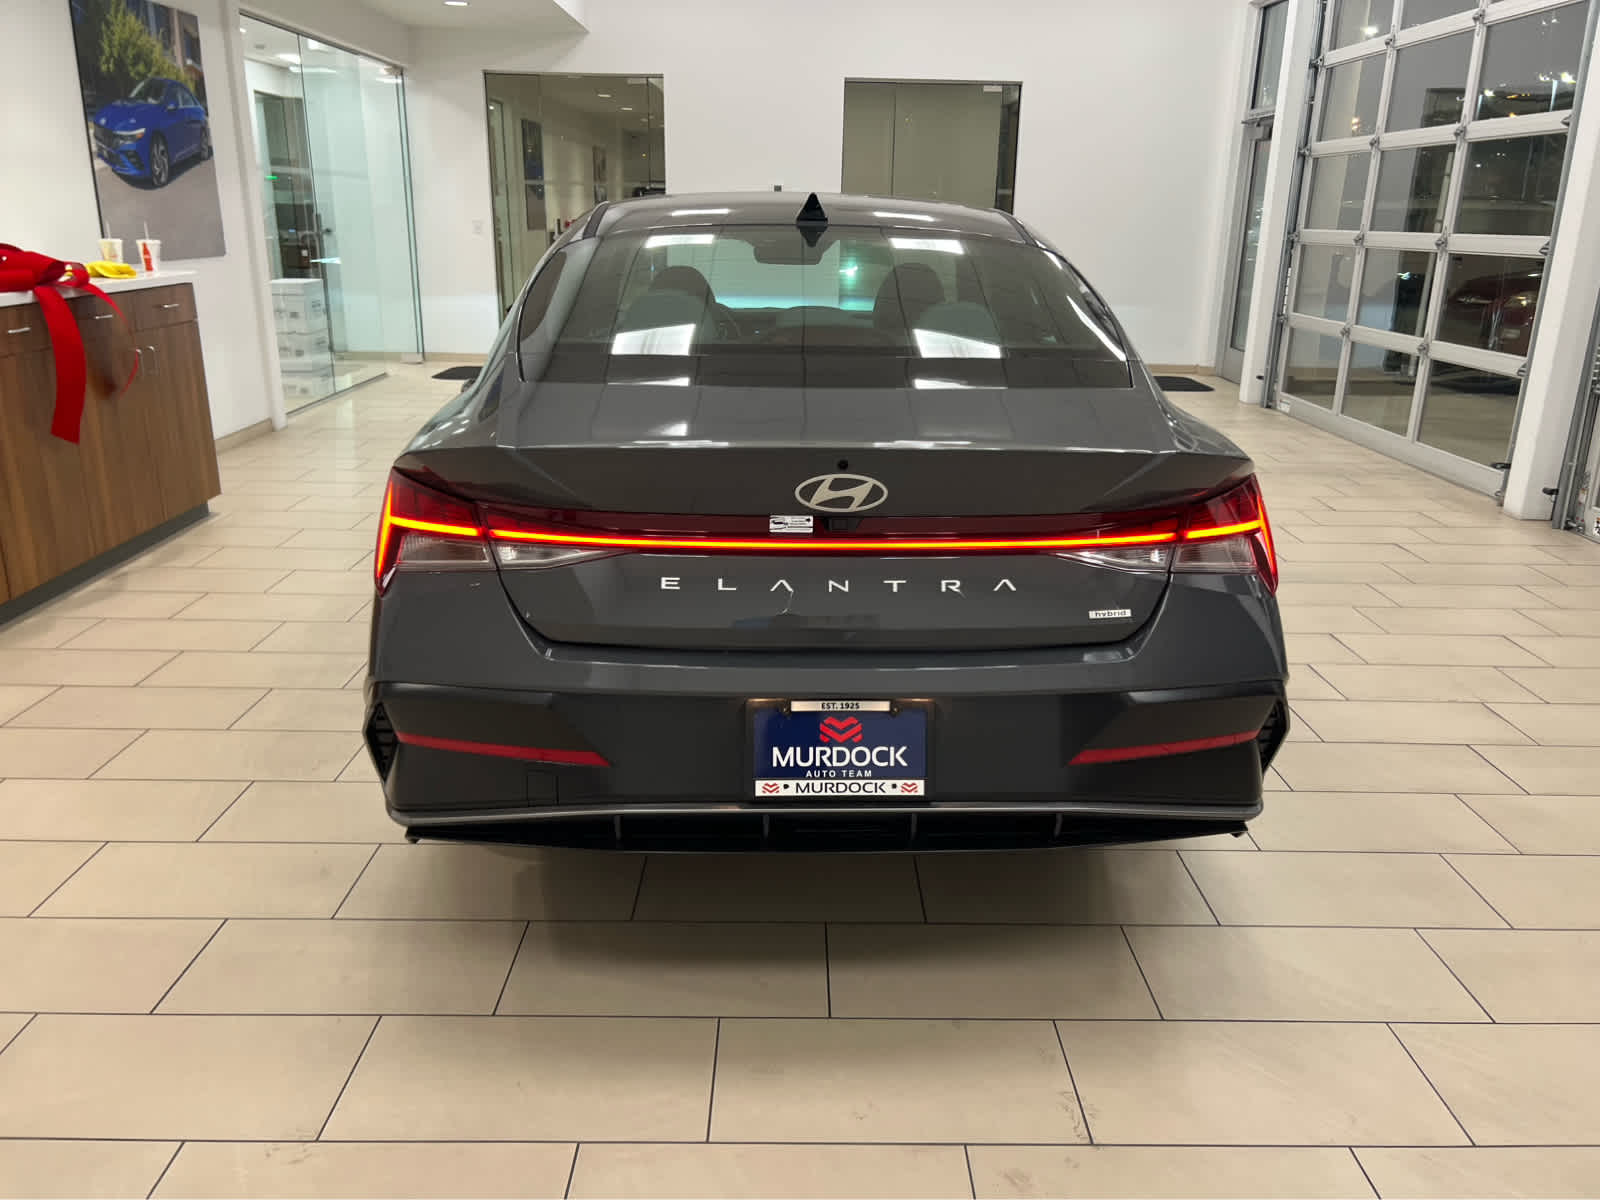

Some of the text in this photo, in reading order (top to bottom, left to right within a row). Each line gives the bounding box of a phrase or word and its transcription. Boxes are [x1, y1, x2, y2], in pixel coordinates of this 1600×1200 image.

[660, 577, 1017, 593] ELANTRA
[1095, 610, 1127, 618] hybrid
[821, 702, 860, 710] EST. 1925
[772, 746, 908, 767] MURDOCK
[806, 769, 872, 778] AUTO TEAM
[795, 782, 887, 794] MURDOCK
